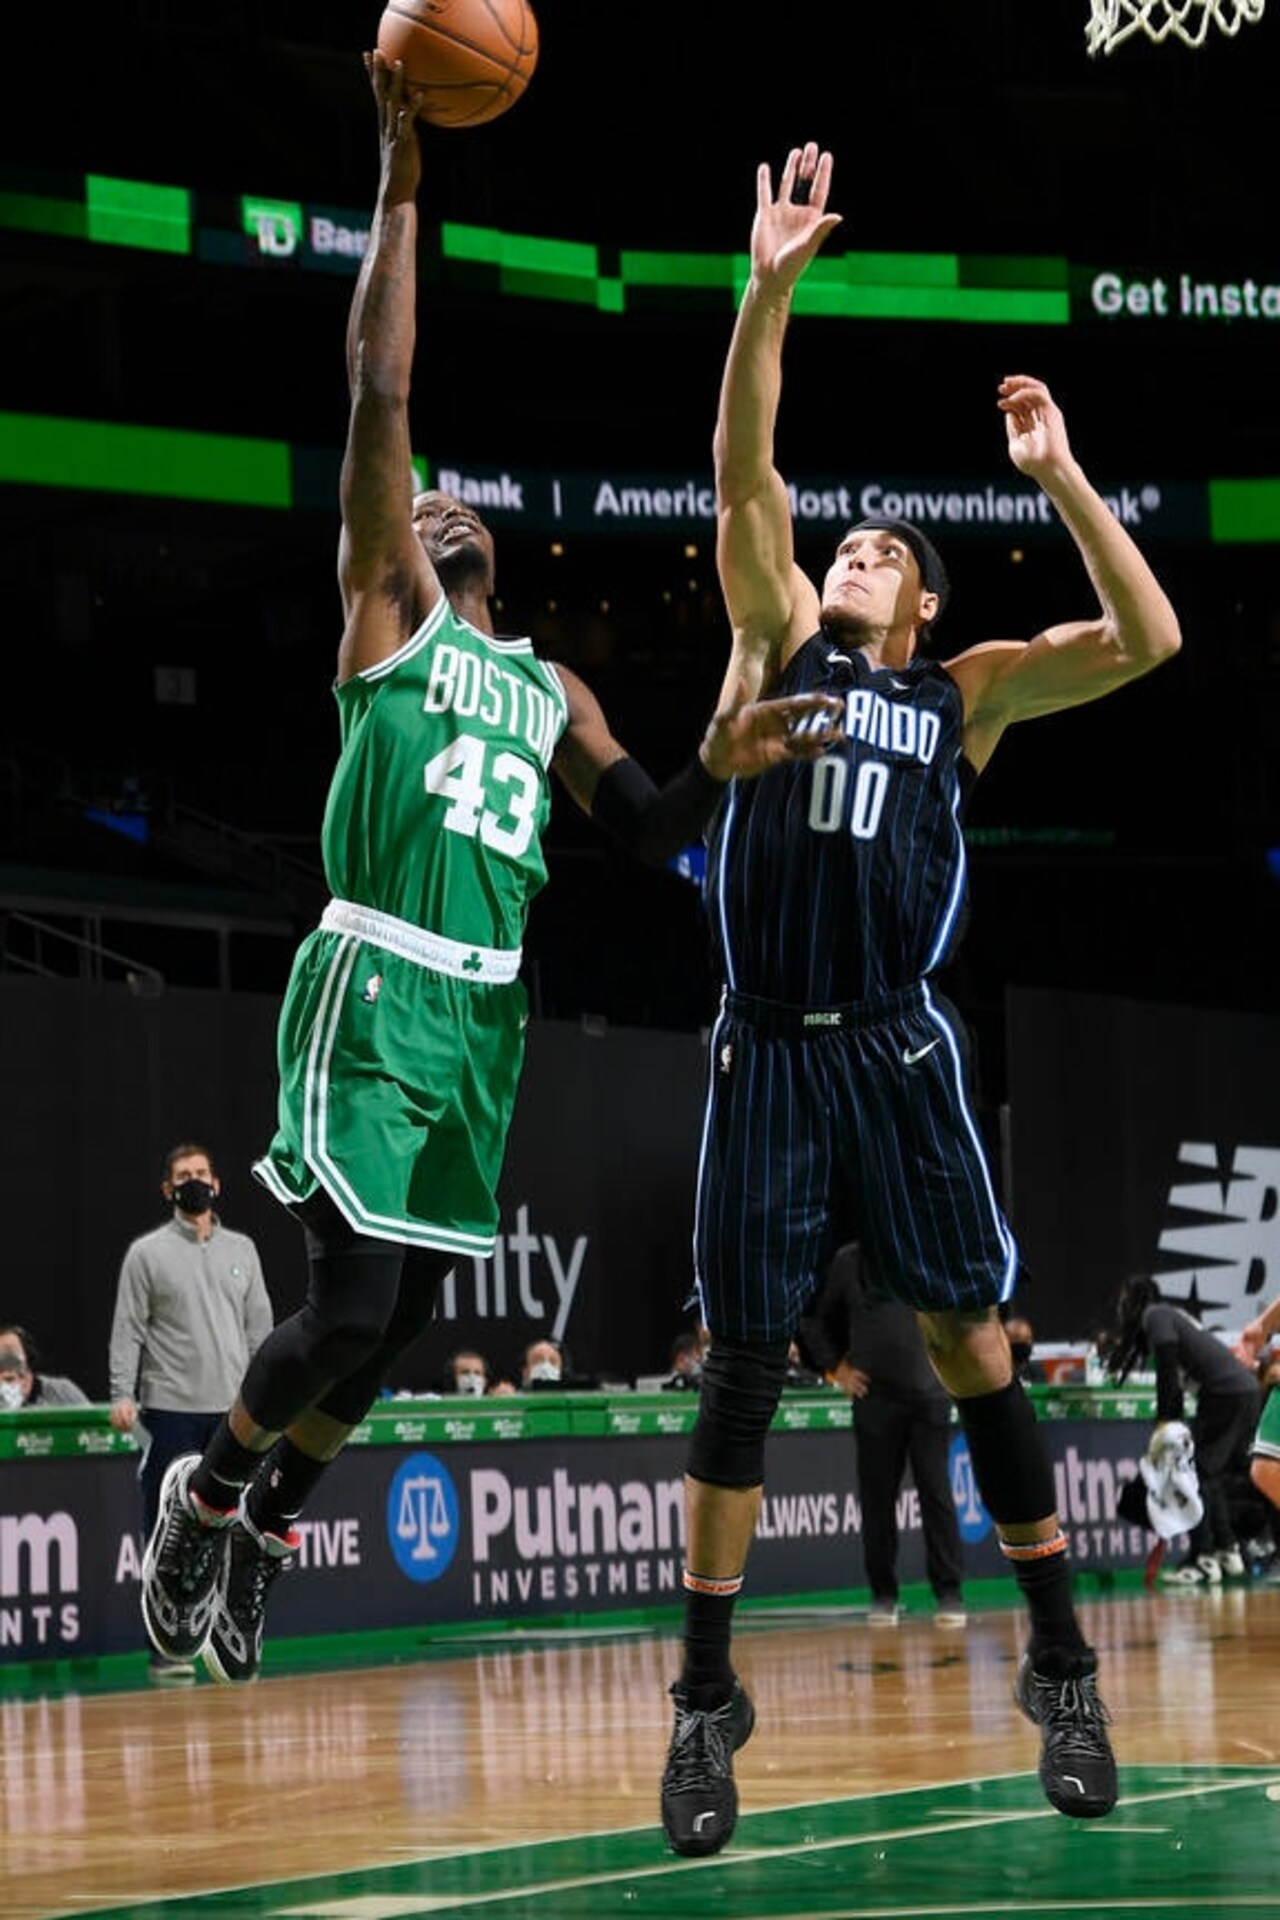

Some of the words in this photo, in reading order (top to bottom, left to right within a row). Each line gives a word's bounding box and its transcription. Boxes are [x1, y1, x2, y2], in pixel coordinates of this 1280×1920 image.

[310, 216, 373, 258] Ban
[1091, 272, 1168, 316] Get
[437, 469, 524, 511] Bank
[594, 481, 718, 517] Americ
[860, 484, 1052, 523] Convenient
[423, 643, 564, 774] BOSTON
[424, 733, 540, 859] 43
[808, 755, 890, 839] 00
[472, 1558, 685, 1605] INVESTMEN
